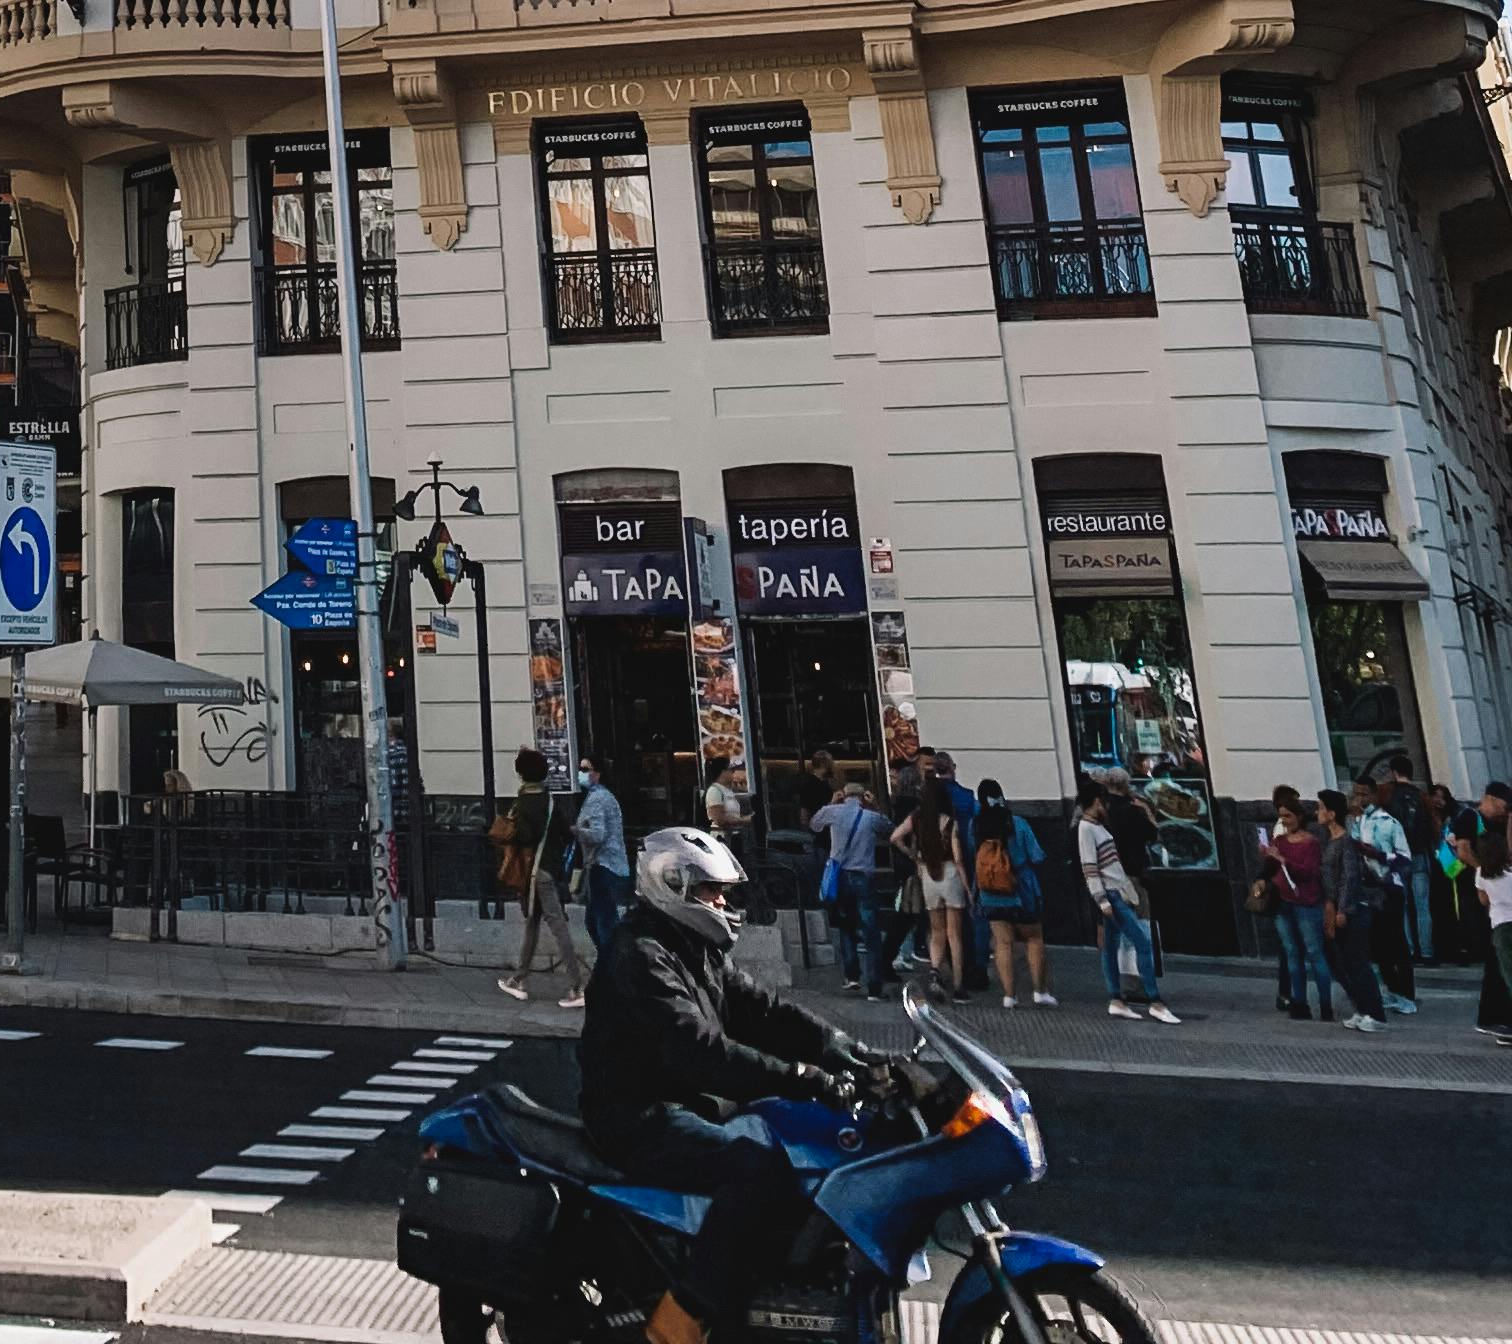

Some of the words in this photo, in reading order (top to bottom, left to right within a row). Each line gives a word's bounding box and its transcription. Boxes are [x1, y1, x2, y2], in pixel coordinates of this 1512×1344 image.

[488, 82, 646, 115] EDIFICIO
[663, 67, 852, 103] VITALICIO
[998, 101, 1059, 112] STARBUCKS
[1059, 98, 1099, 109] COFFEE
[708, 122, 766, 135] STARBUCKS
[767, 119, 804, 131] COFFEE
[544, 132, 601, 145] STARBUCKS
[600, 130, 637, 142] COFFEE
[274, 142, 328, 153] STARBUCKS
[8, 421, 70, 434] ESTRELLA
[595, 515, 645, 542] bar
[738, 509, 849, 546] tapería
[1047, 512, 1166, 532] restaurante
